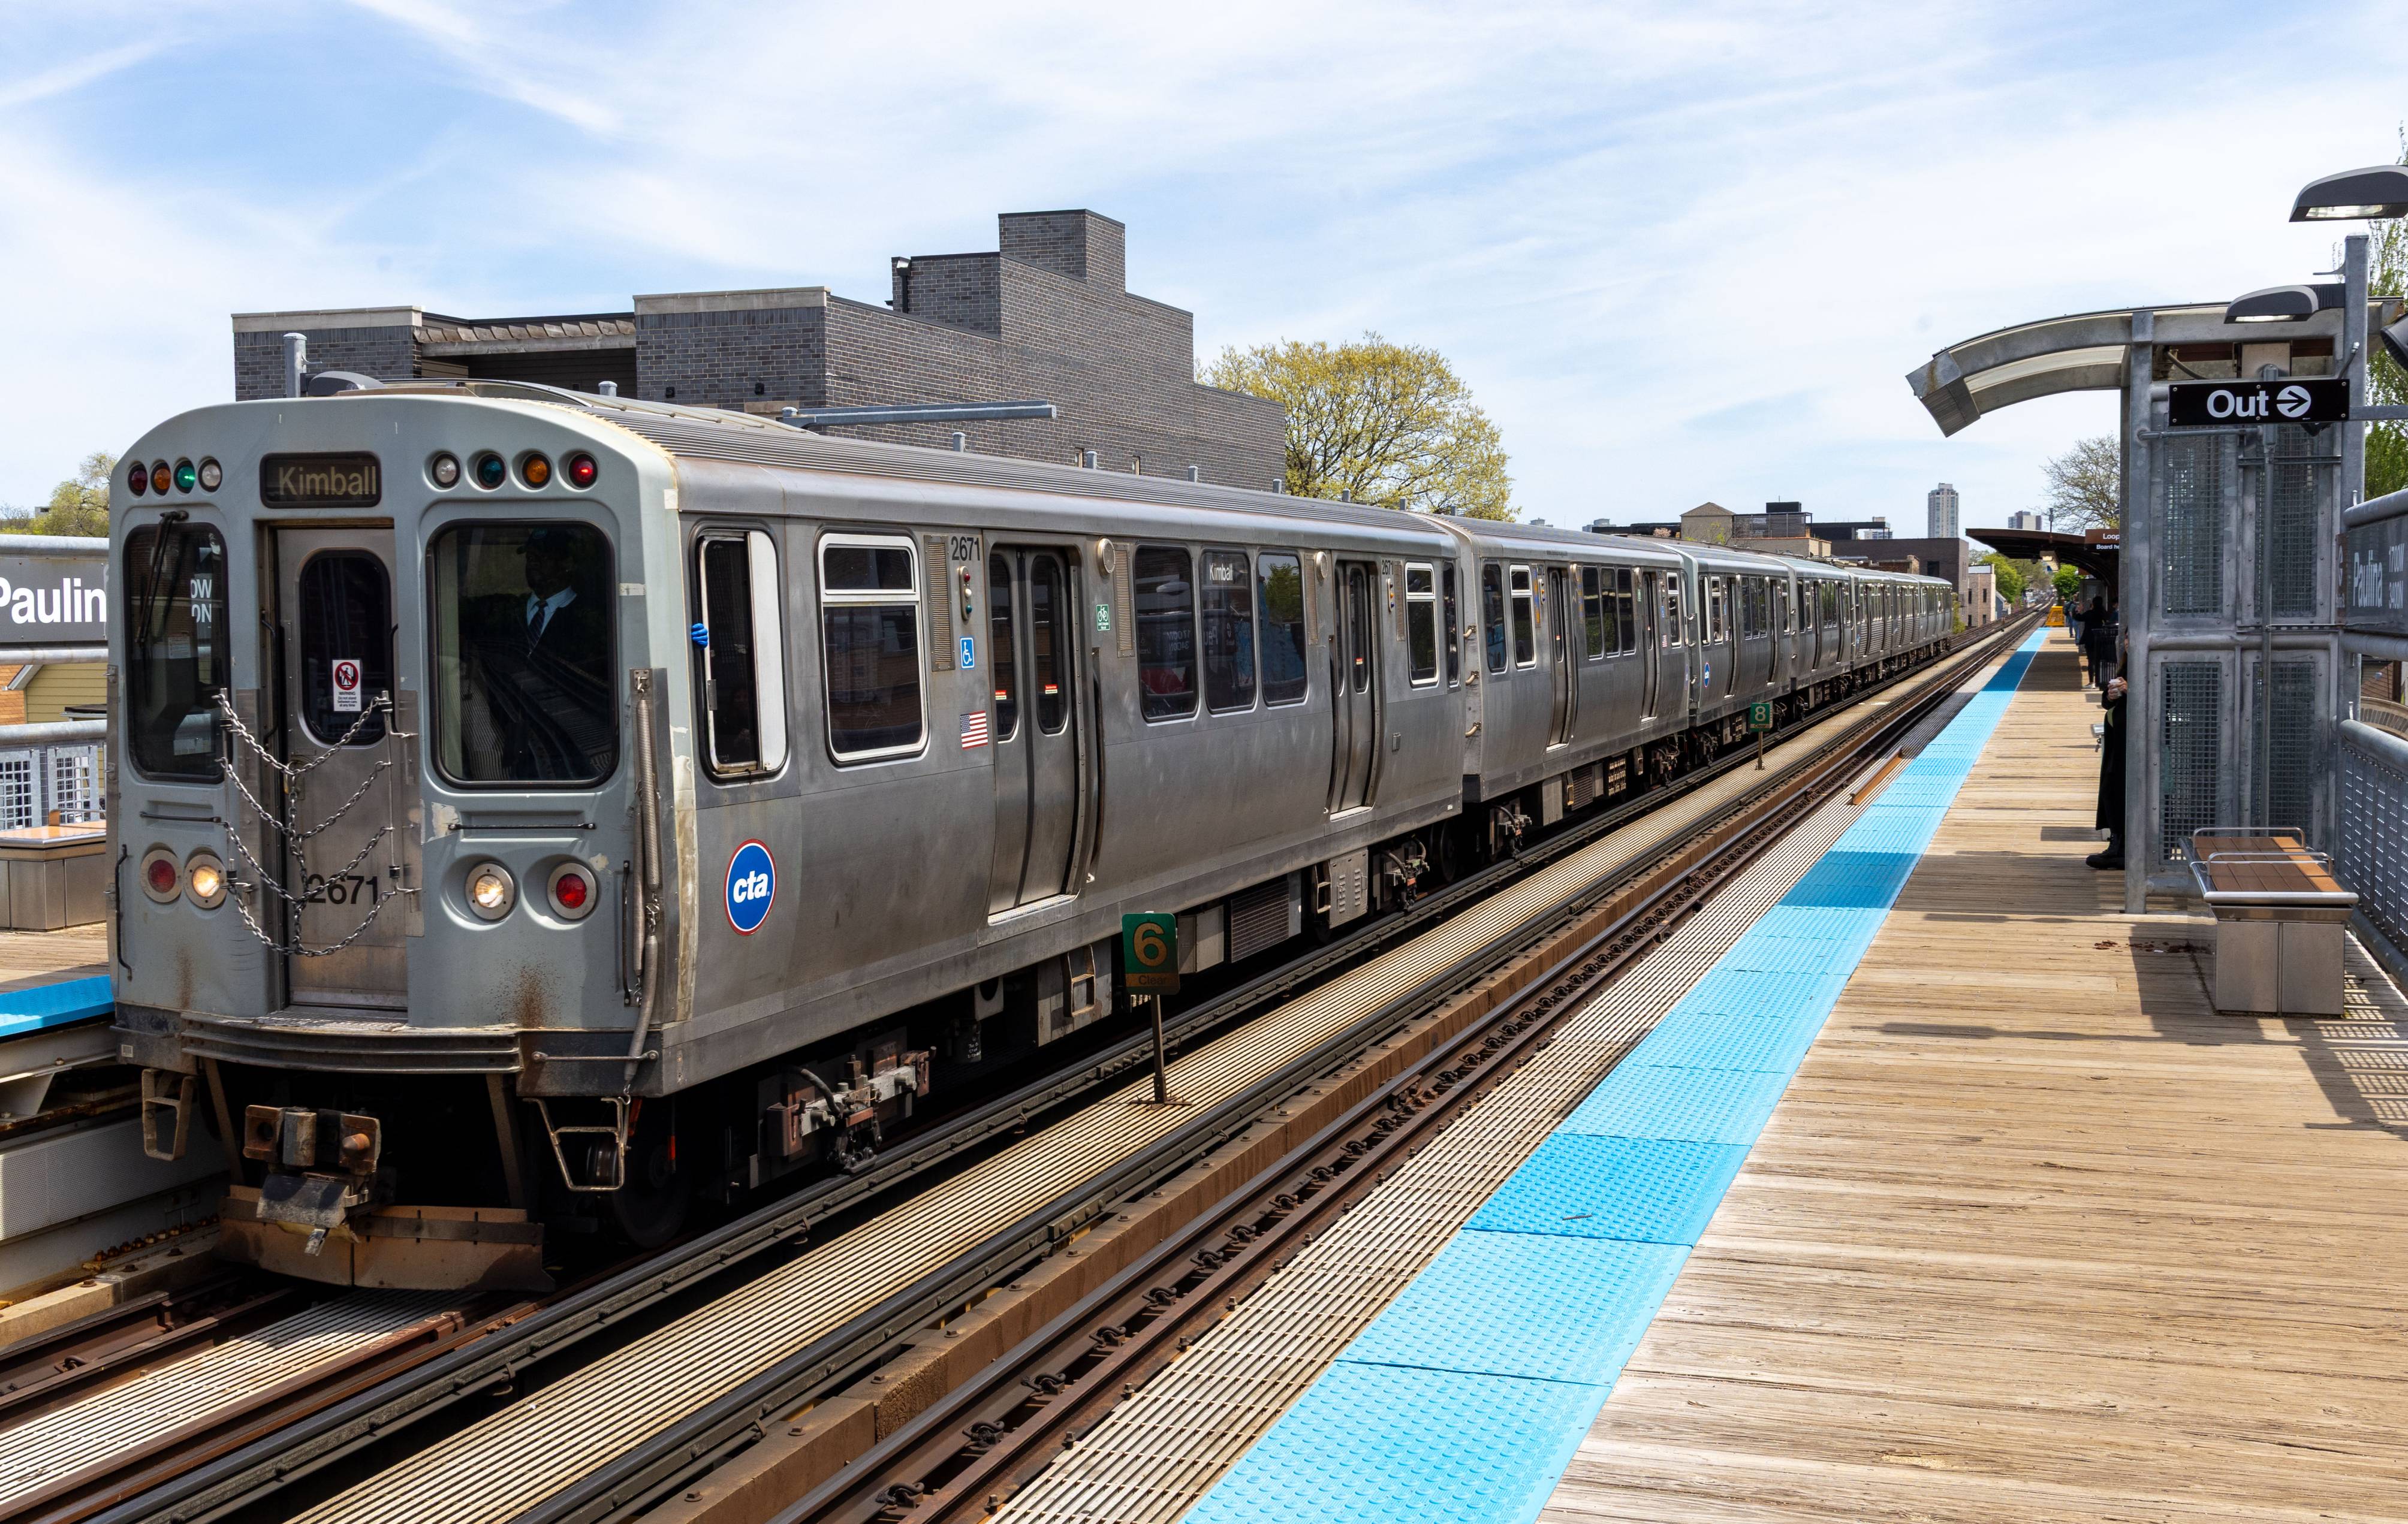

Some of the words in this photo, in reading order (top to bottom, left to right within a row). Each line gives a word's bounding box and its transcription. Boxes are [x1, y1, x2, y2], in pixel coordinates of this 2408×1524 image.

[2207, 390, 2269, 418] Out
[278, 466, 376, 495] Kimball
[951, 536, 980, 561] 2671
[1209, 563, 1233, 581] Kimball
[1382, 560, 1393, 575] 2671
[2353, 550, 2382, 608] Paulina
[1755, 706, 1766, 722] 8
[308, 874, 378, 905] 2671
[733, 870, 768, 903] cta
[1133, 922, 1168, 967] 6
[1138, 974, 1166, 985] Clear
